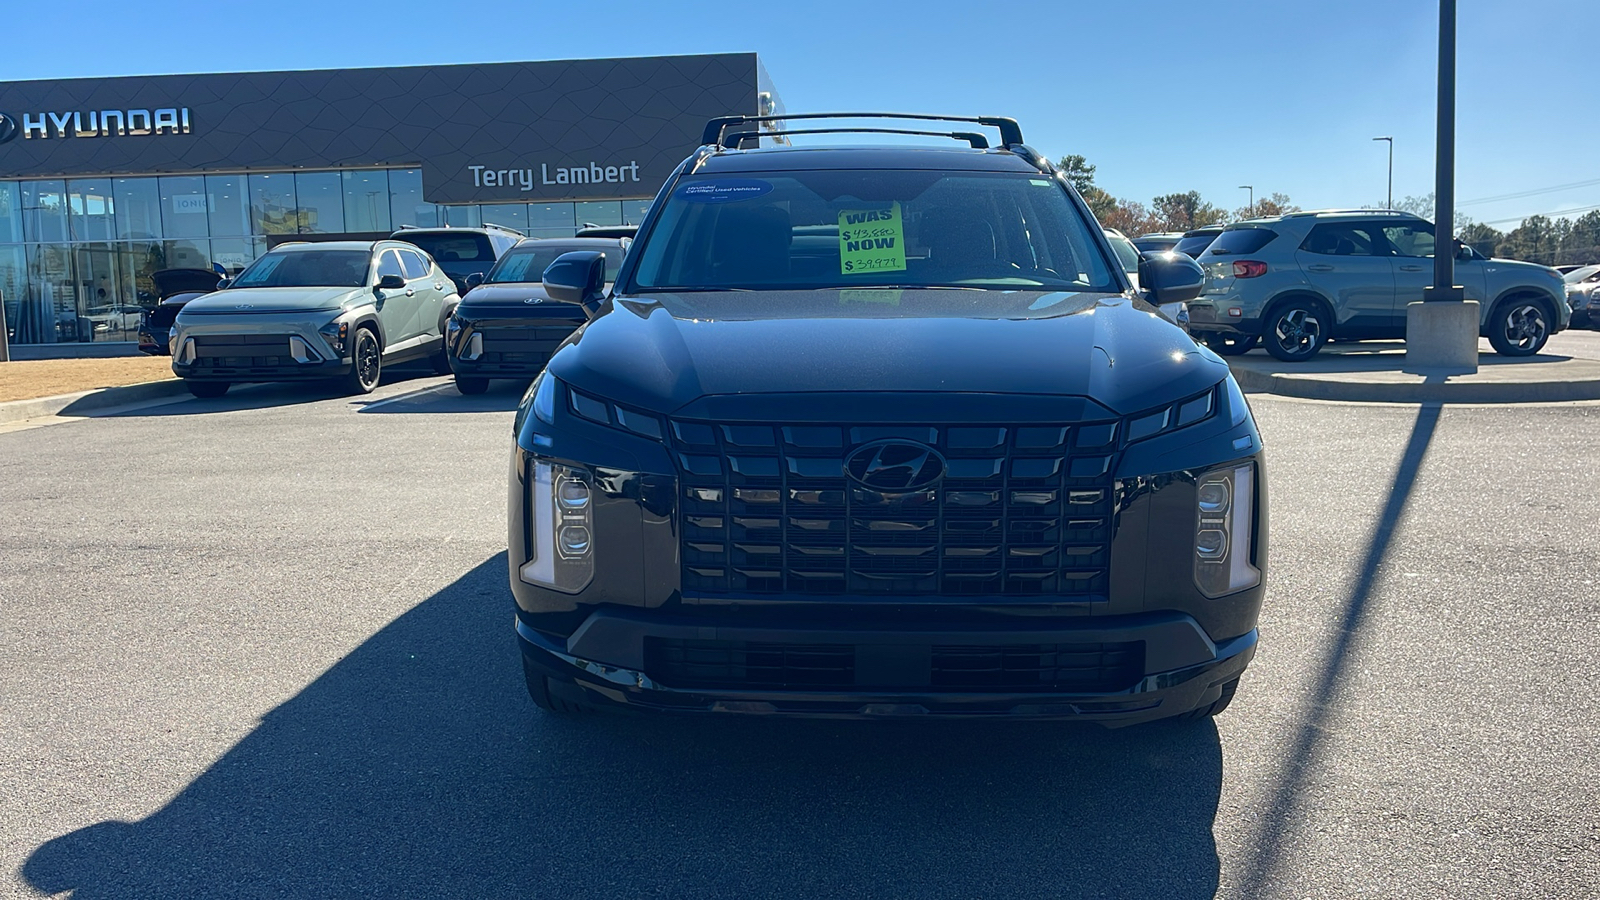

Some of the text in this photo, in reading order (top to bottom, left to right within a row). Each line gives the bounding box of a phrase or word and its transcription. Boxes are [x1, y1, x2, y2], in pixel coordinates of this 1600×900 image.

[23, 107, 190, 139] HYUNDAI
[468, 160, 640, 191] Terry Lambert
[846, 210, 893, 225] WAS
[847, 238, 895, 252] NOW
